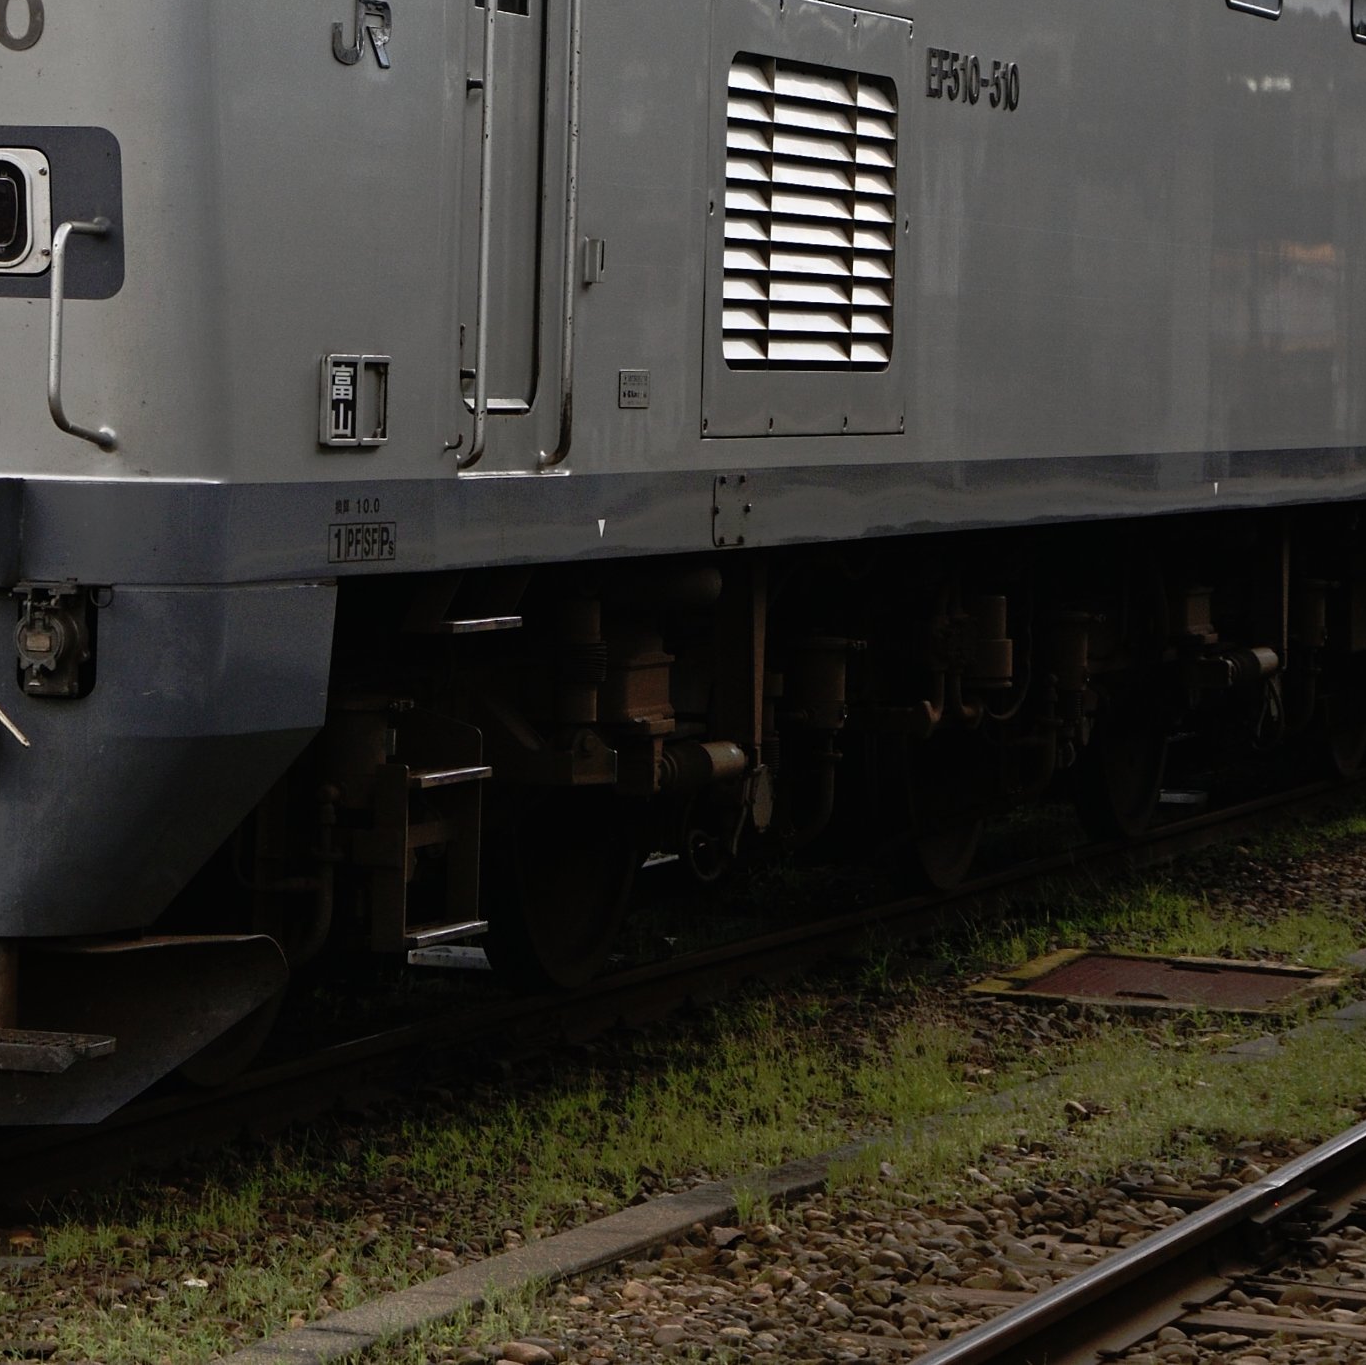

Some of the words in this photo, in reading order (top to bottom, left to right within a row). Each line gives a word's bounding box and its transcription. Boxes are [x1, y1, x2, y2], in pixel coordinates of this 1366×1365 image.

[926, 46, 1020, 112] EF510-510
[332, 364, 354, 437] 富山
[356, 497, 380, 514] 10.0
